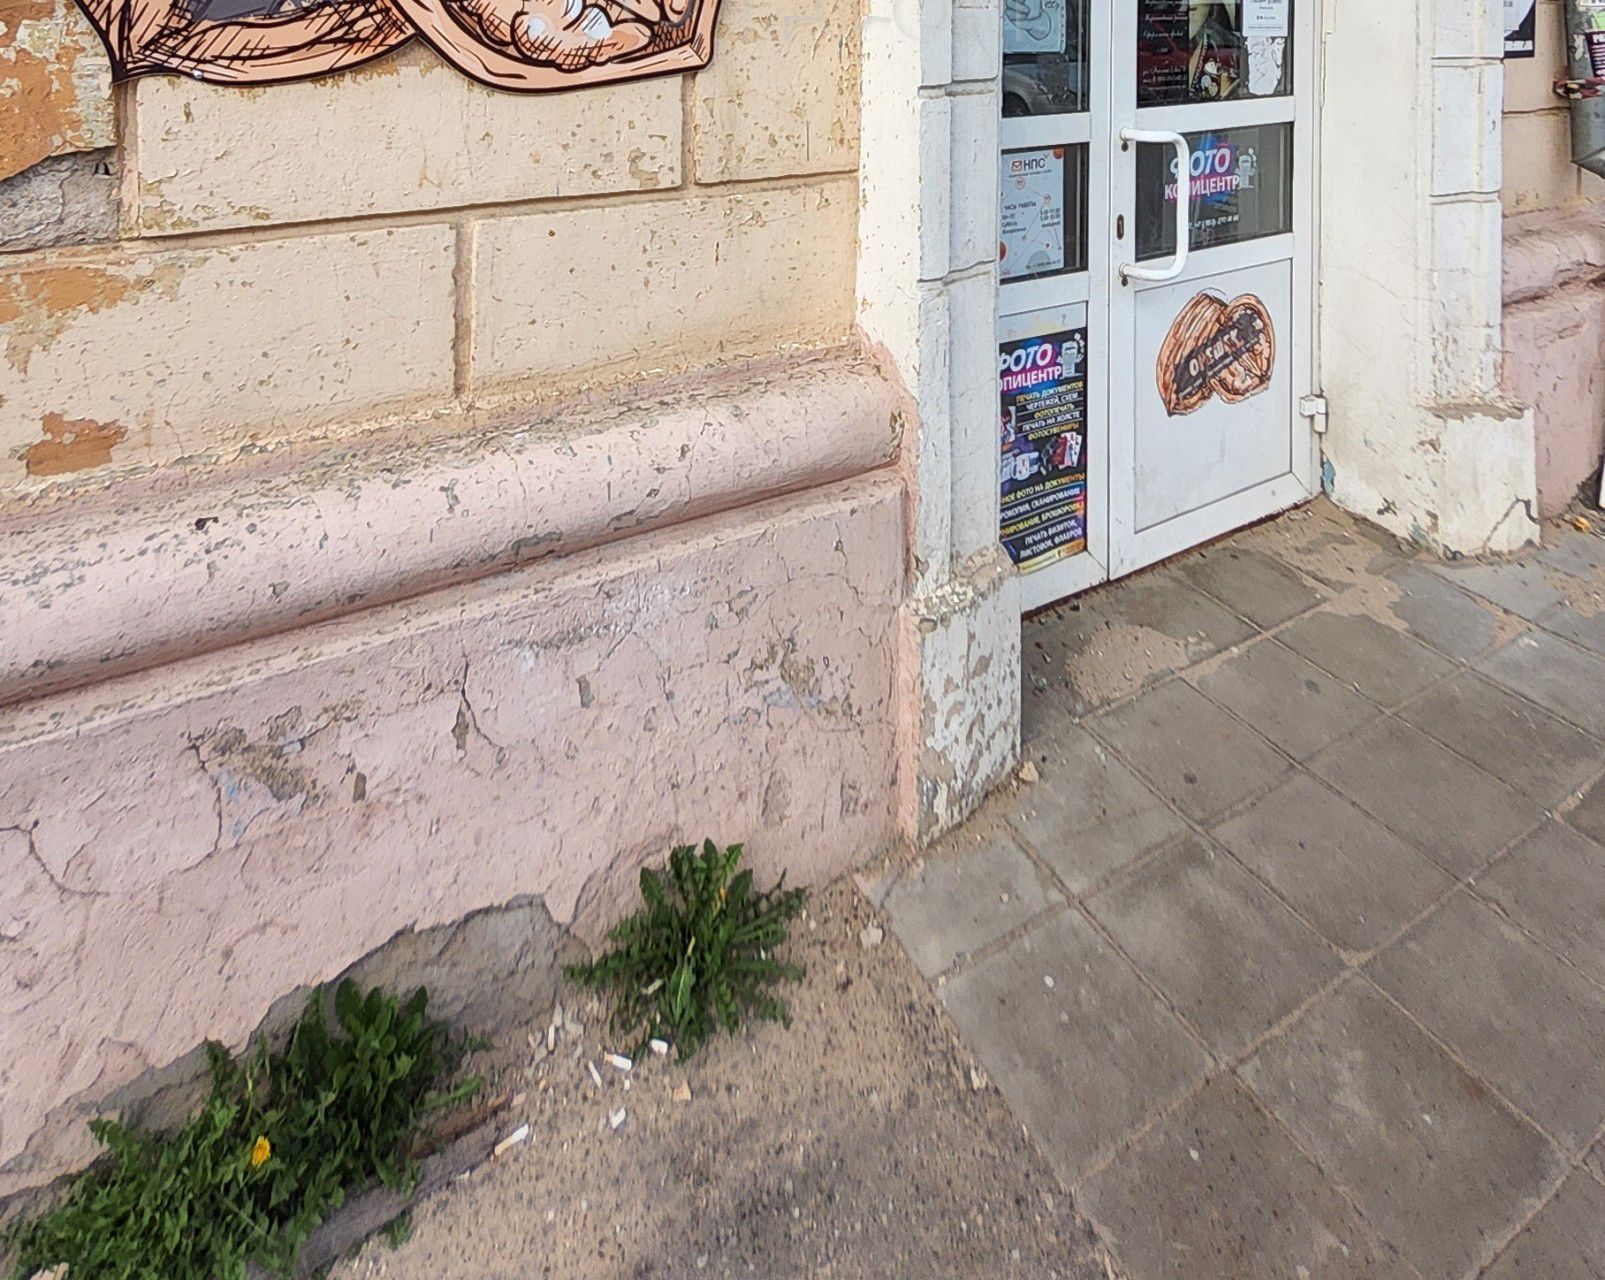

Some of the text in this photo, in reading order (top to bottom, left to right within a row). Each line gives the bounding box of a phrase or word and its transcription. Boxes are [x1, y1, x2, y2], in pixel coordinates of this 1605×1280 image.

[1023, 157, 1046, 171] НПС
[1164, 174, 1240, 201] КОИЦЕНТР
[1000, 366, 1062, 391] ПИЦЕНТР
